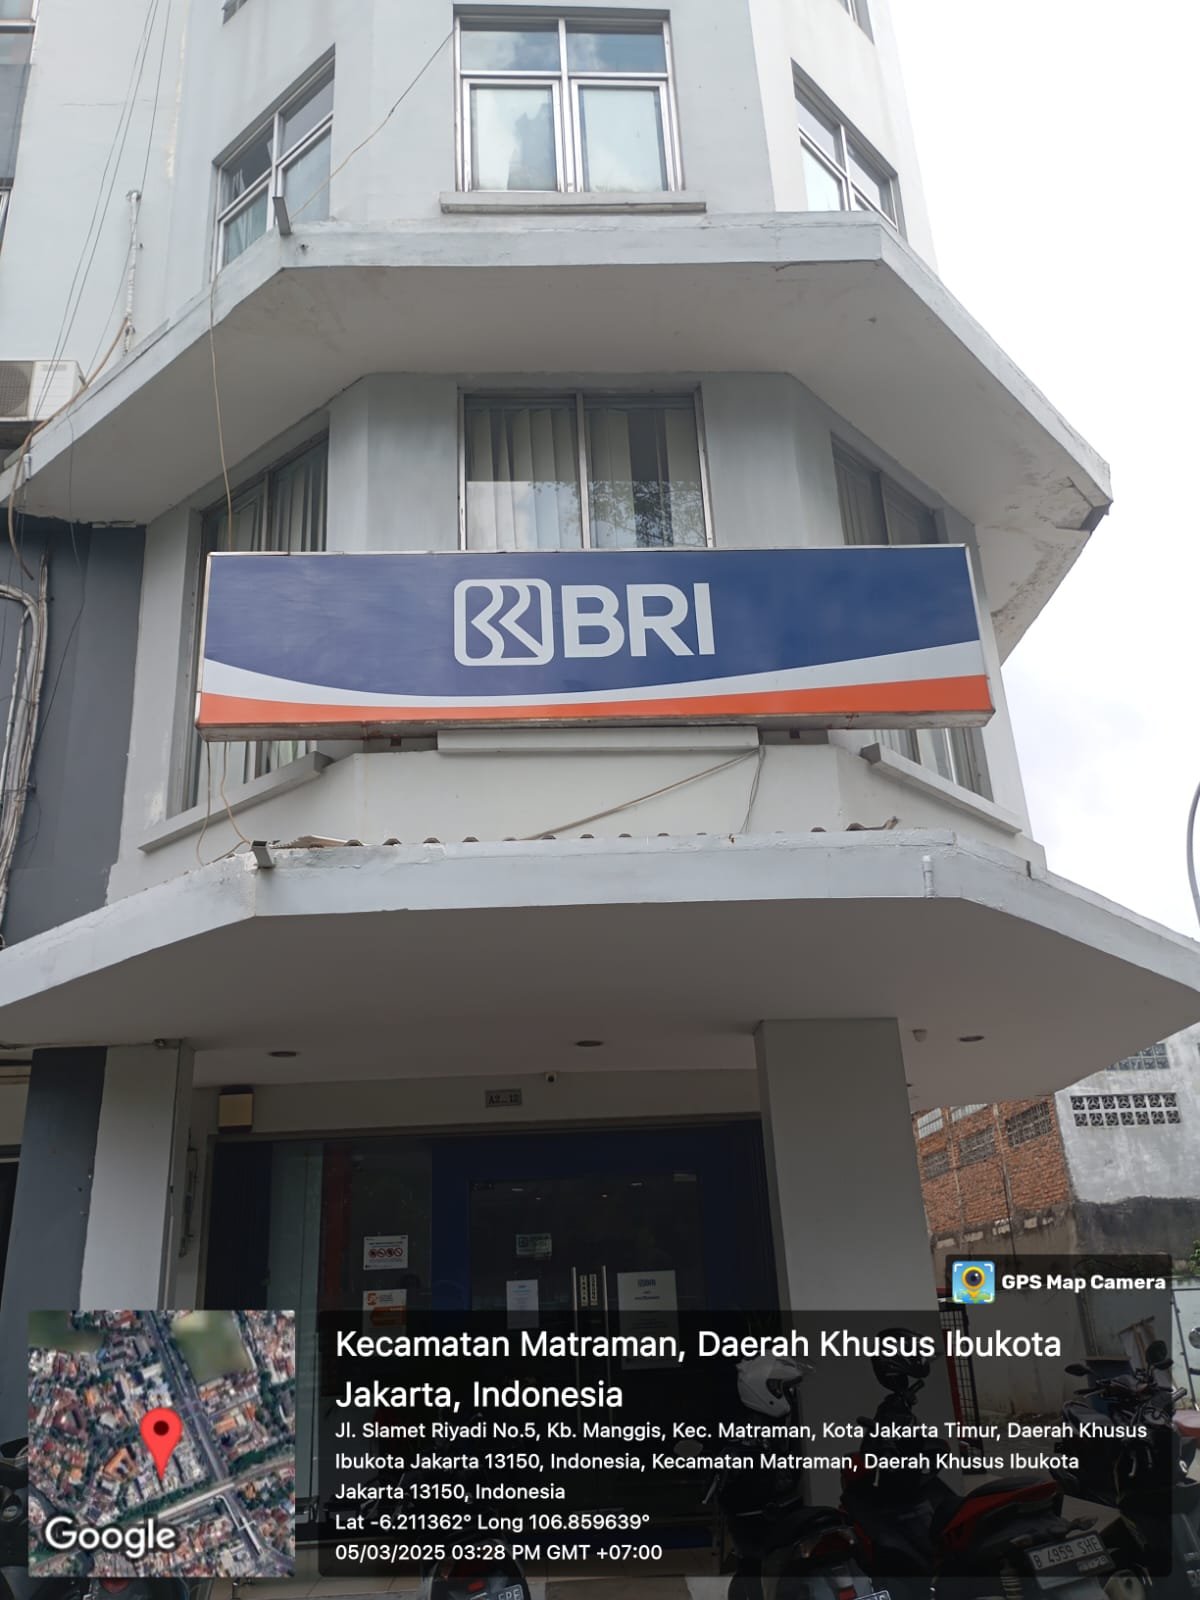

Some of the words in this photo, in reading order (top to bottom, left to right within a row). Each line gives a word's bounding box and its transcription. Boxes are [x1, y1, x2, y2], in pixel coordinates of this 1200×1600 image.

[561, 582, 716, 658] BRI
[1033, 1554, 1042, 1568] B
[1047, 1544, 1074, 1563] 4959
[1077, 1536, 1101, 1554] SHE
